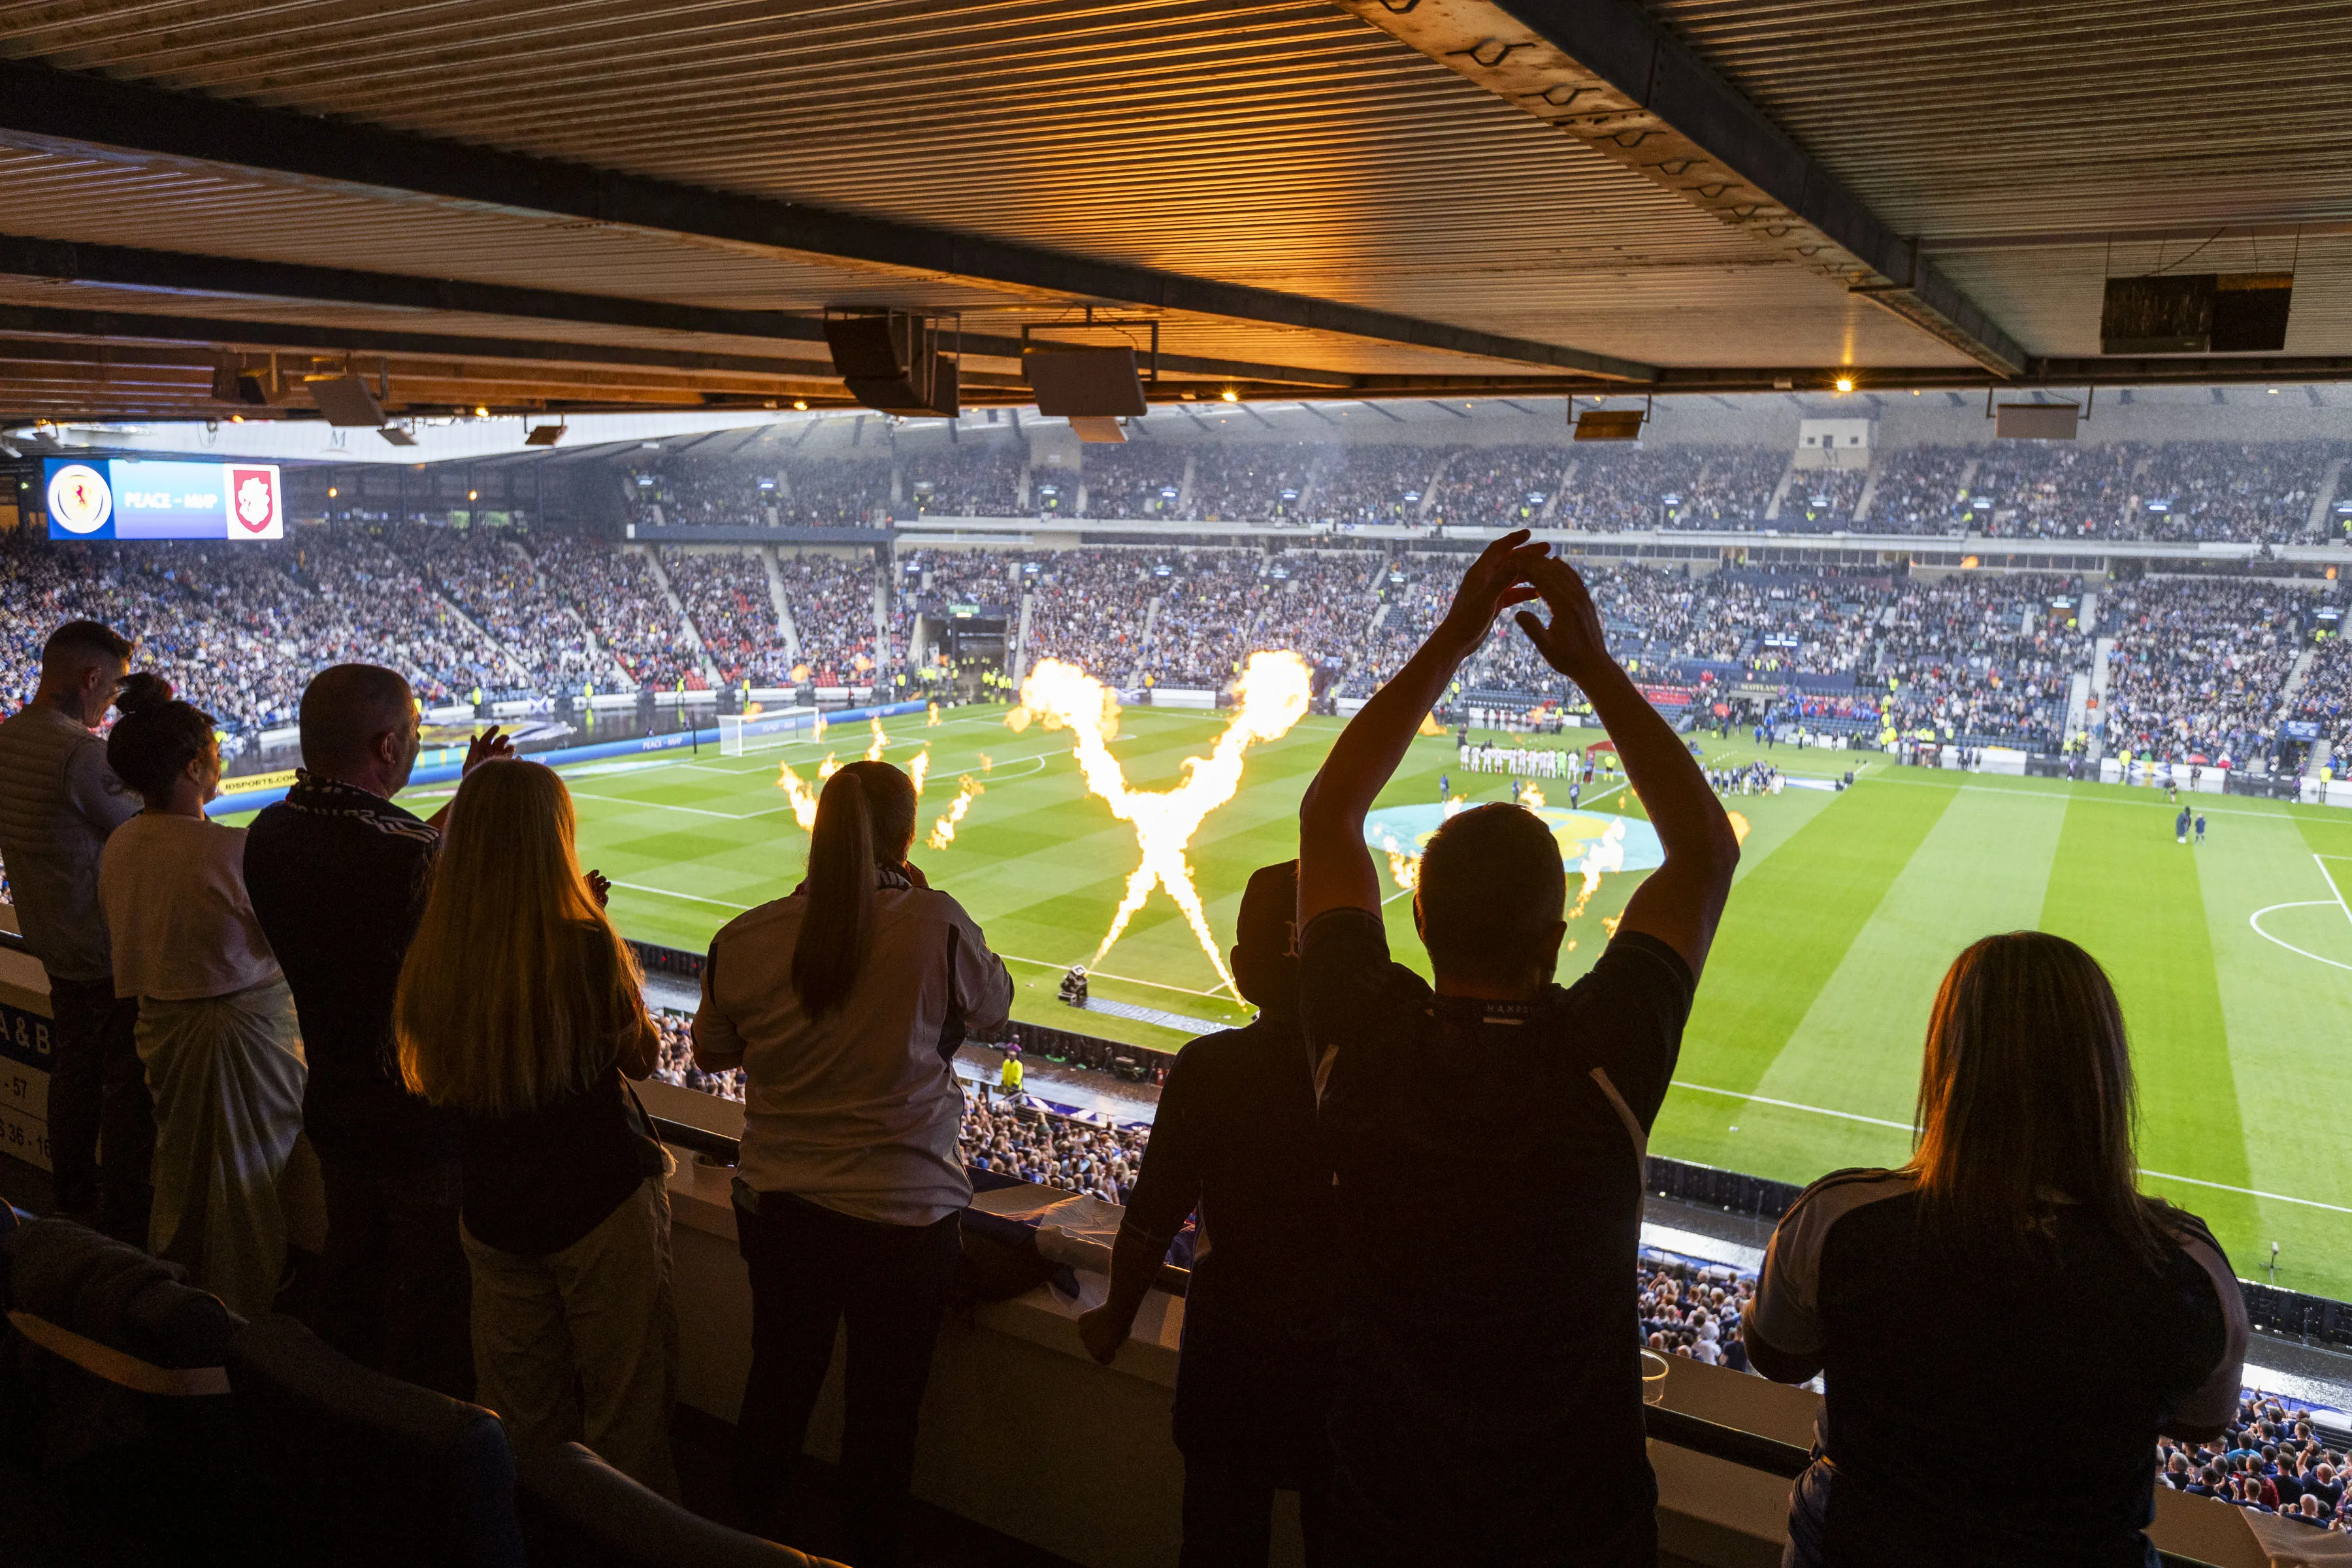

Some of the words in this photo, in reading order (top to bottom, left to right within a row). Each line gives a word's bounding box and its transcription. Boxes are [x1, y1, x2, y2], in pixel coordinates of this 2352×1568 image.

[1740, 683, 1779, 693] SCOTLAN
[16, 1016, 29, 1049] &
[36, 1023, 50, 1054] B
[13, 1076, 27, 1099] 57
[8, 1123, 24, 1145] 36
